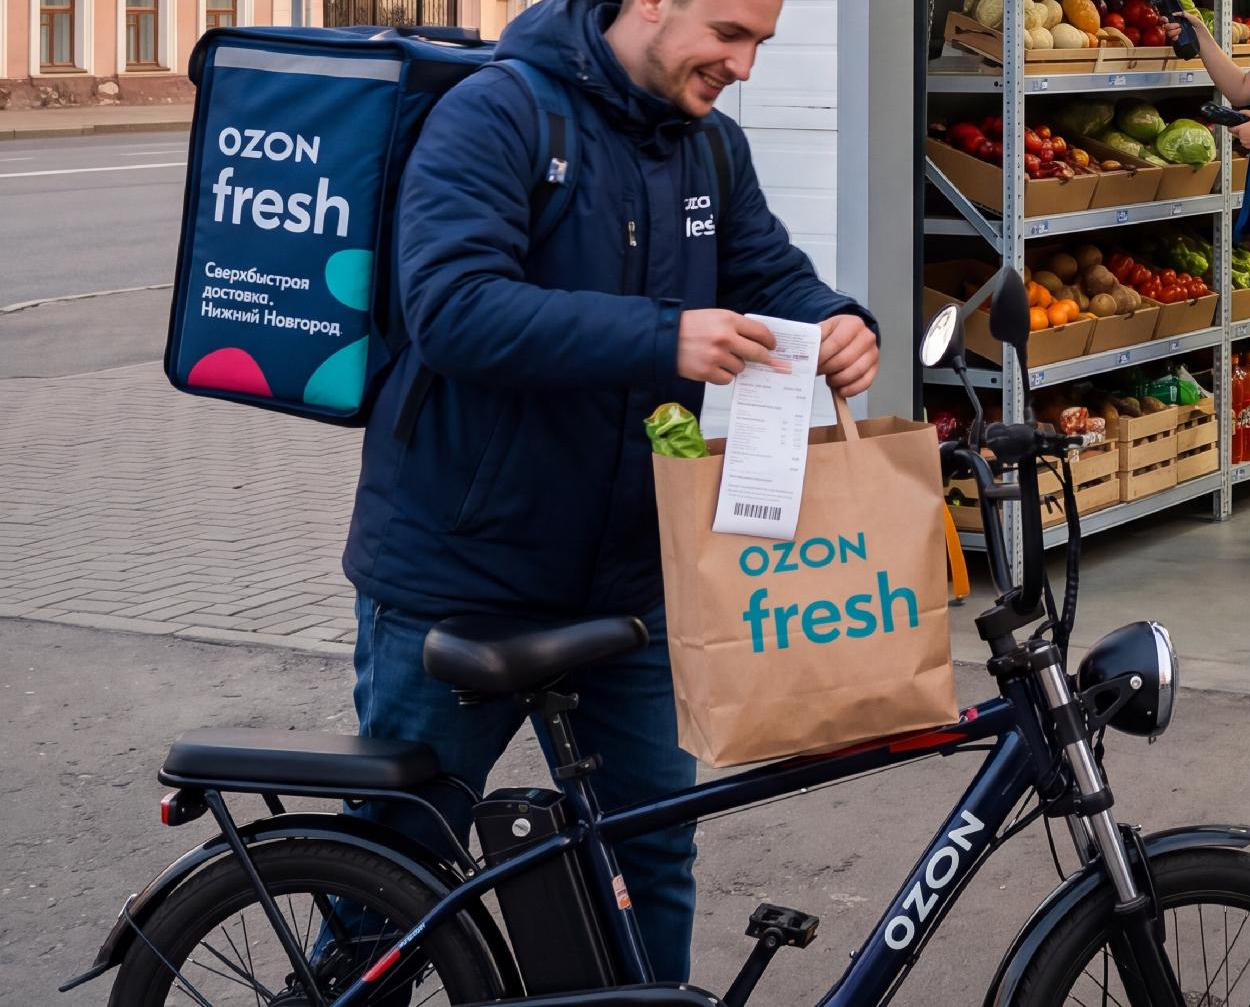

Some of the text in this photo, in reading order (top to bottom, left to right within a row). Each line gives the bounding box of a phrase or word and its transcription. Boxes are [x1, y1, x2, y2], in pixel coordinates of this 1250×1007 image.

[218, 126, 321, 165] OZON
[212, 166, 350, 238] fresh
[201, 301, 260, 324] Нижний
[739, 532, 867, 577] OZON
[742, 571, 919, 653] fresh
[884, 809, 986, 951] OZON
